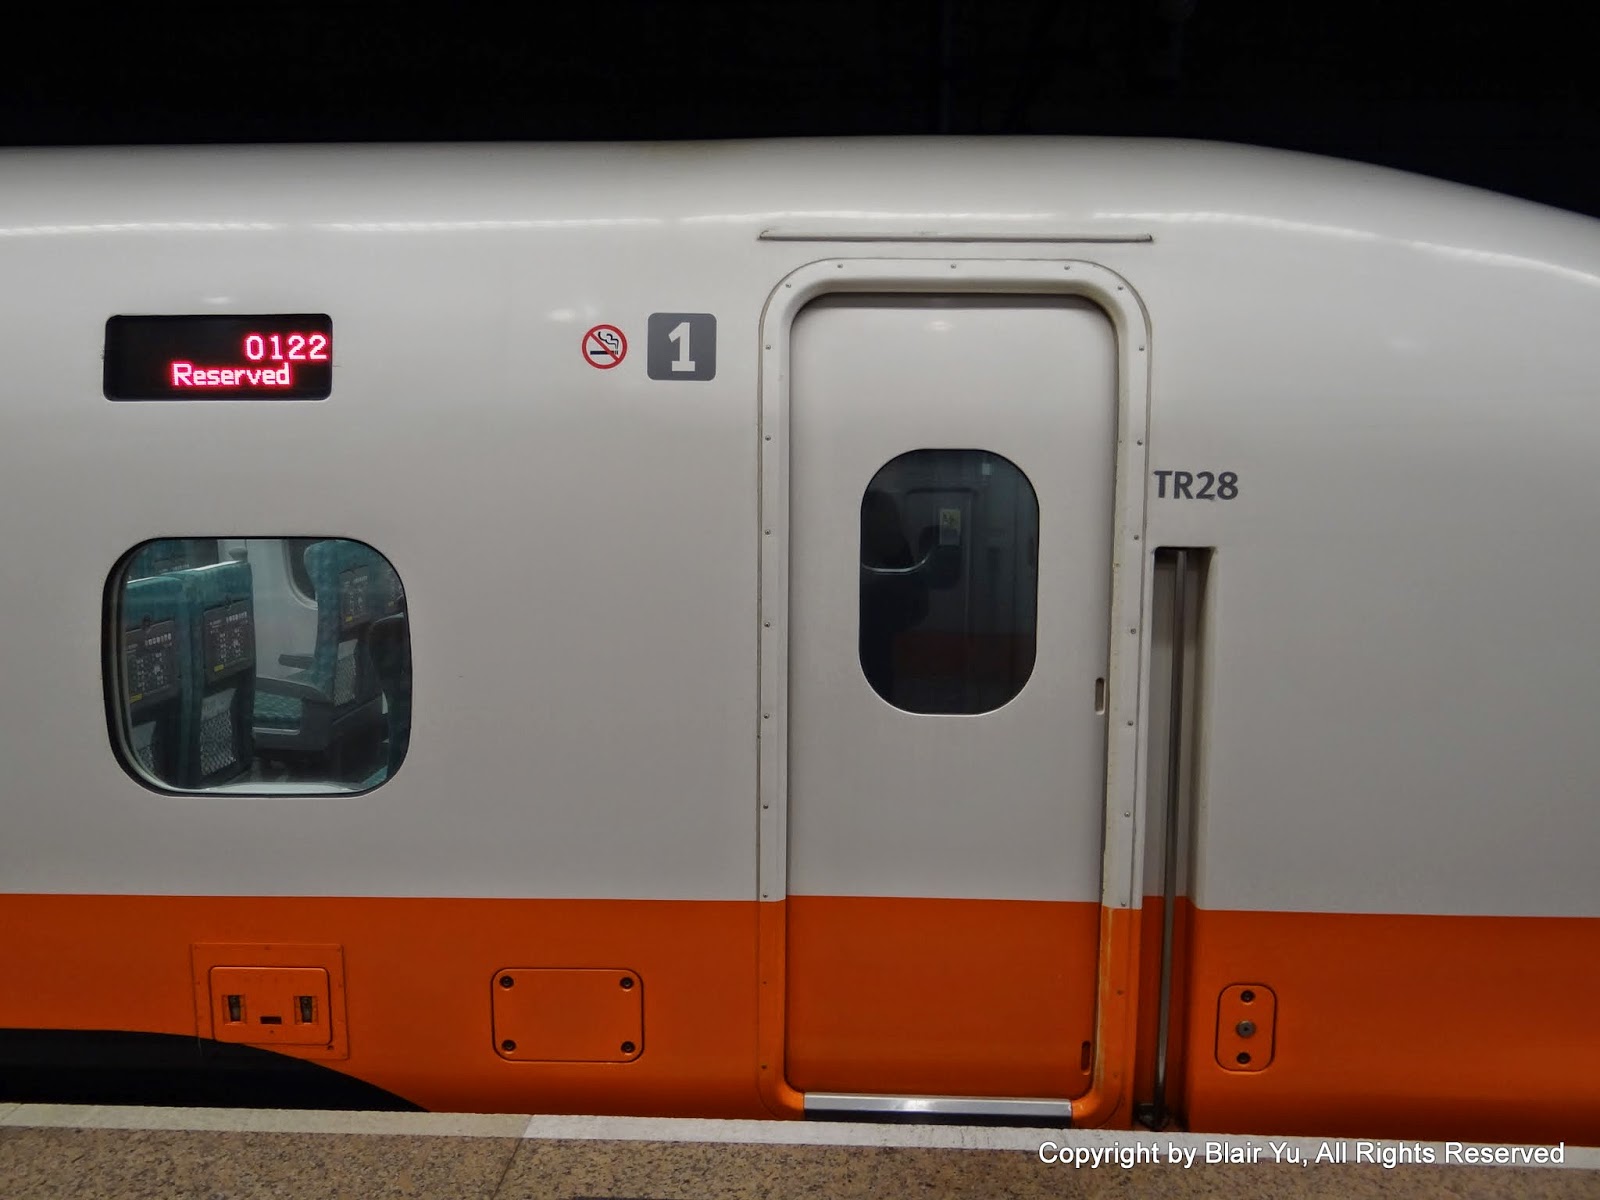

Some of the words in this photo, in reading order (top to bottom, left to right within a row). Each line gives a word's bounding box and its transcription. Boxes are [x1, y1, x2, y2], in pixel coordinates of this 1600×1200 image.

[245, 334, 328, 361] 0122
[668, 321, 696, 372] 1
[172, 362, 291, 387] Reserved
[1153, 470, 1239, 500] TR28
